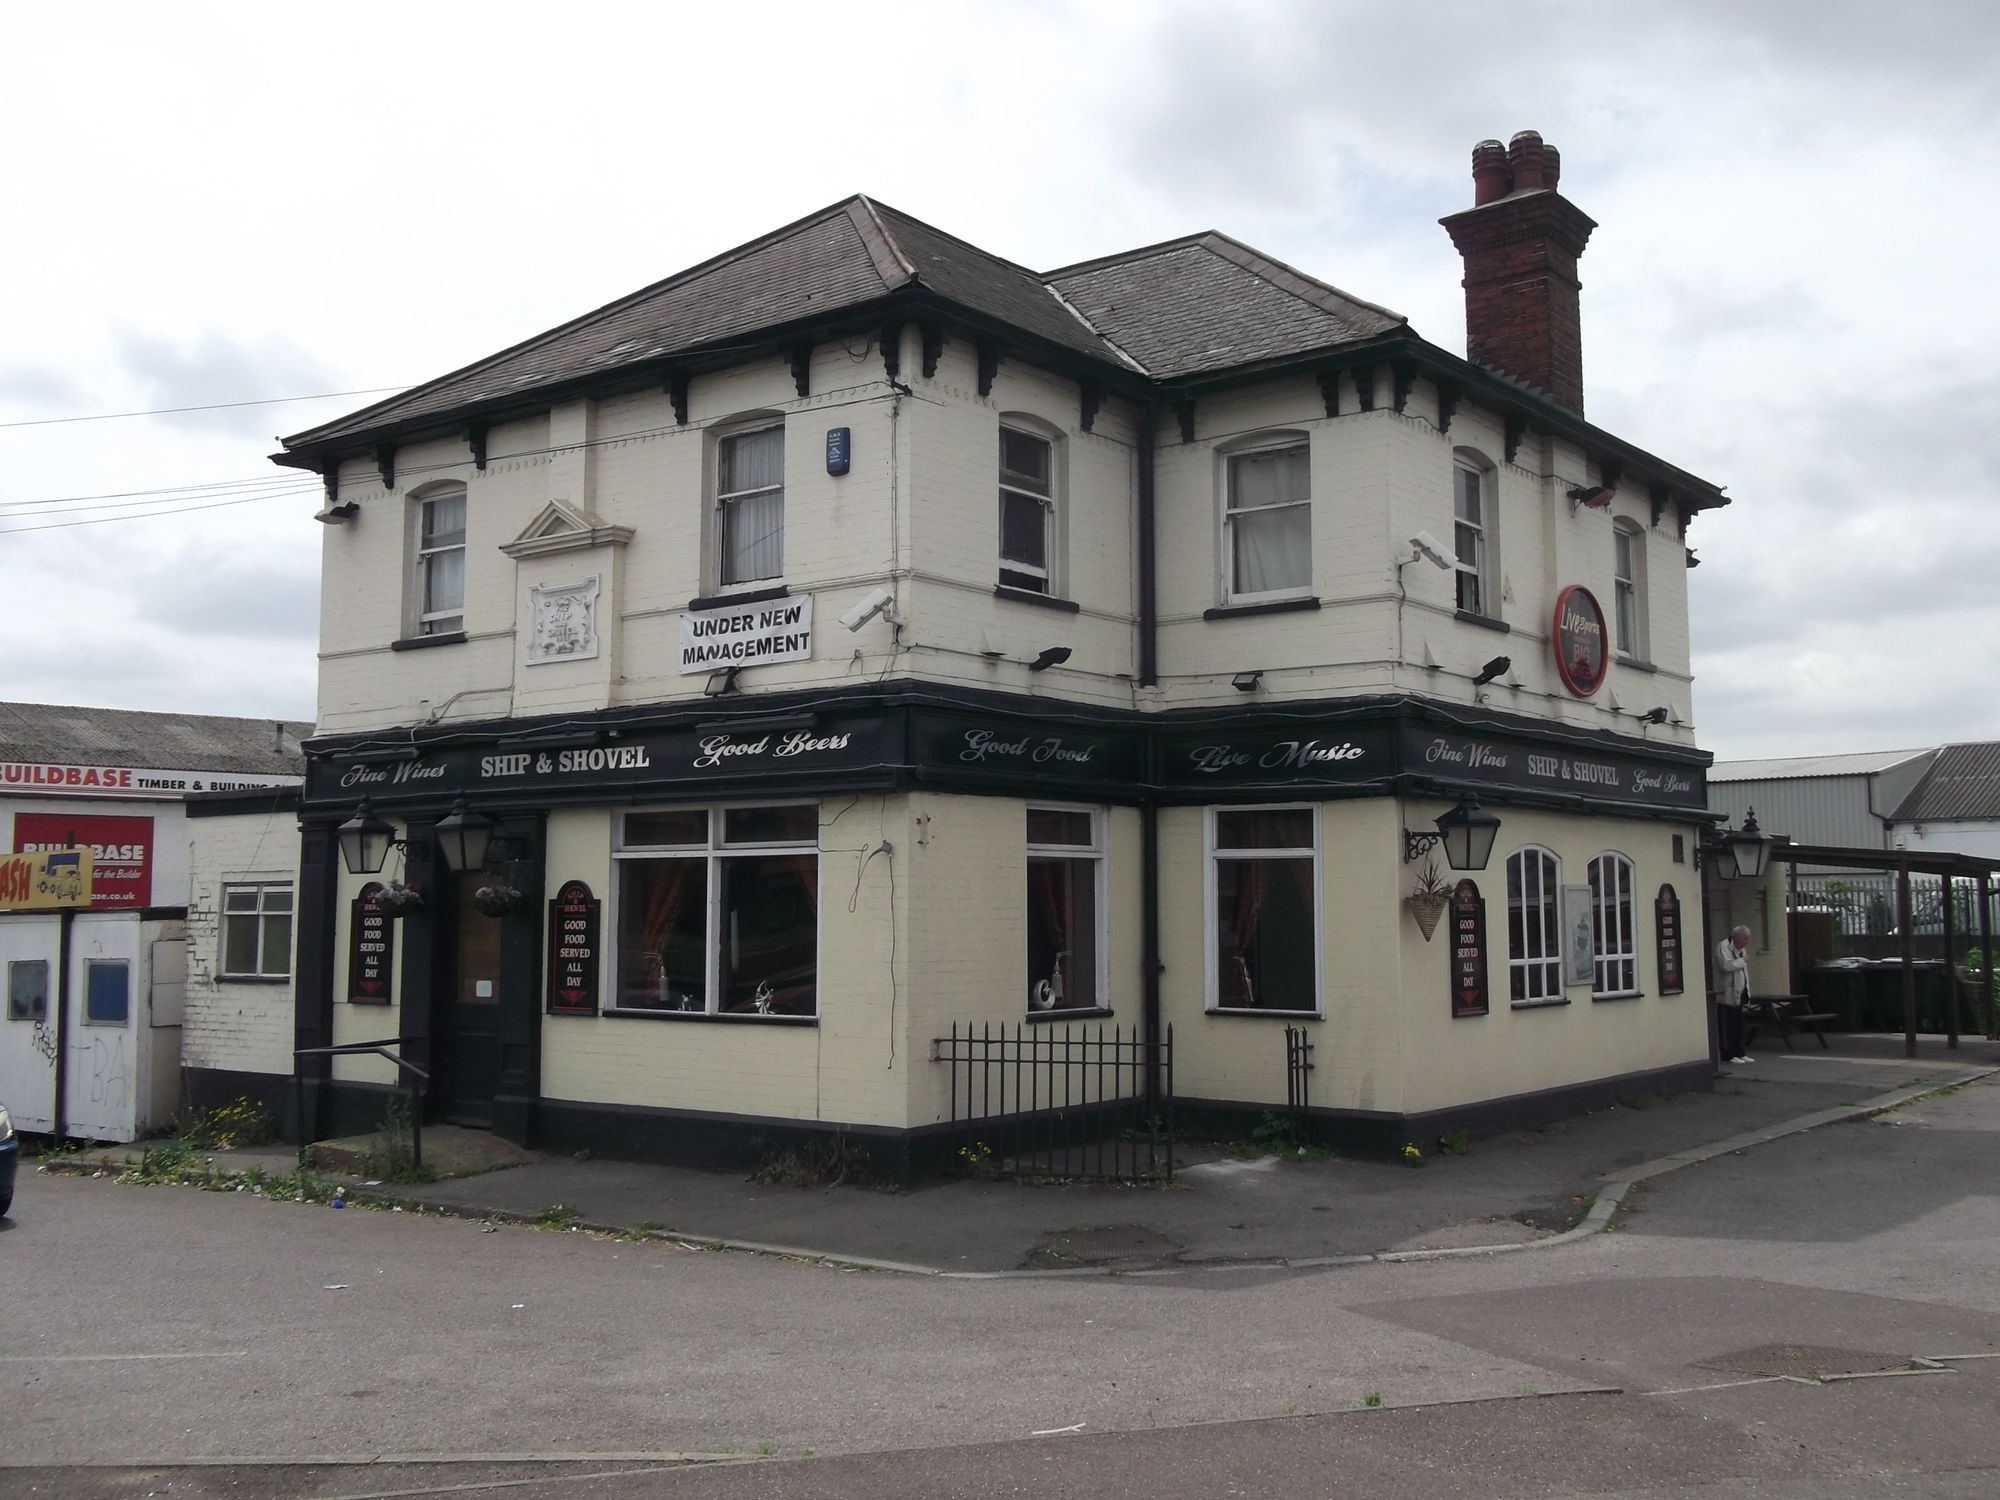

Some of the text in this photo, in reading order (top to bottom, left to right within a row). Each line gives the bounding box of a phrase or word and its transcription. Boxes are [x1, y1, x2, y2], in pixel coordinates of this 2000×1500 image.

[692, 605, 801, 638] UNDER NEW
[682, 632, 810, 665] MANAGEMENT
[959, 729, 1095, 763] Good Food
[340, 729, 851, 788] Fine Wines SHIP & SHOVEL Good Beers
[1188, 739, 1366, 773] Live Music
[1426, 738, 1691, 793] Fine Wines SHIP & SHOVEL Good Beers
[0, 765, 131, 788] UILDBASE
[138, 778, 186, 790] TIMBER
[192, 780, 203, 791] &
[103, 869, 116, 879] the
[116, 868, 142, 879] Builder
[91, 892, 135, 900] ase.co.uk
[364, 917, 382, 926] GOOD
[564, 920, 586, 930] GOOD
[1459, 920, 1475, 929] GOOD
[364, 930, 382, 939] FOOD
[564, 934, 585, 944] FOOD
[1460, 934, 1475, 944] FOOD
[360, 943, 385, 952] SERVED
[560, 948, 590, 958] SERVED
[1457, 948, 1478, 958] SERVED
[365, 956, 378, 965] ALL
[566, 963, 582, 972] ALL
[1463, 962, 1474, 972] ALL
[365, 969, 378, 978] DAY
[566, 977, 582, 986] DAY
[1463, 976, 1474, 987] DAY
